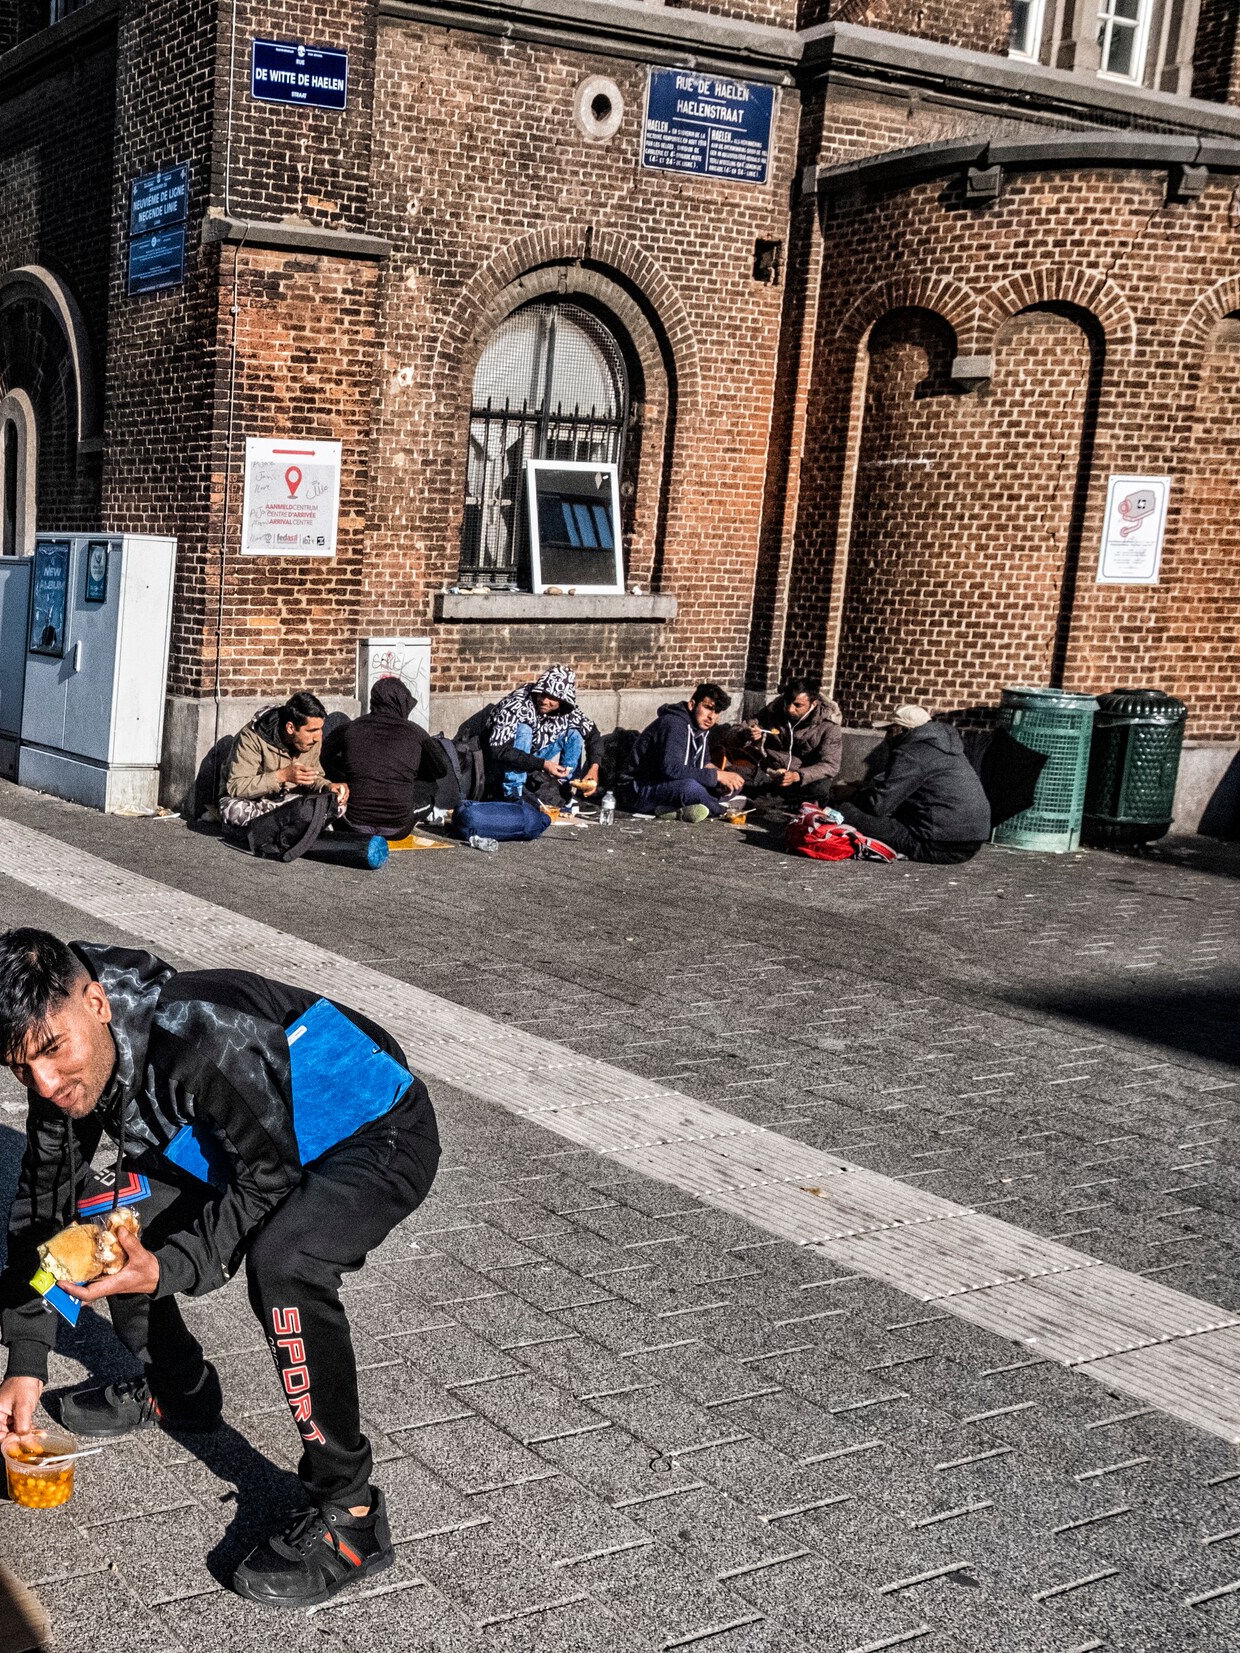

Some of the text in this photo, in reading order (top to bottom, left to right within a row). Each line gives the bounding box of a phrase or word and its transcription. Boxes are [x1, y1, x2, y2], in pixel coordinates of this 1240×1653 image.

[256, 67, 344, 91] DE WITTE DE HAELEN
[676, 76, 749, 102] RUE DE HAELEN
[291, 91, 307, 99] STRAAT
[677, 100, 745, 123] HAELENSTRAAT
[134, 185, 184, 211] NEUVIÈME DE LIGNE
[138, 206, 162, 222] NEGENDE
[43, 567, 62, 577] NEW
[272, 1306, 327, 1446] SPORT
